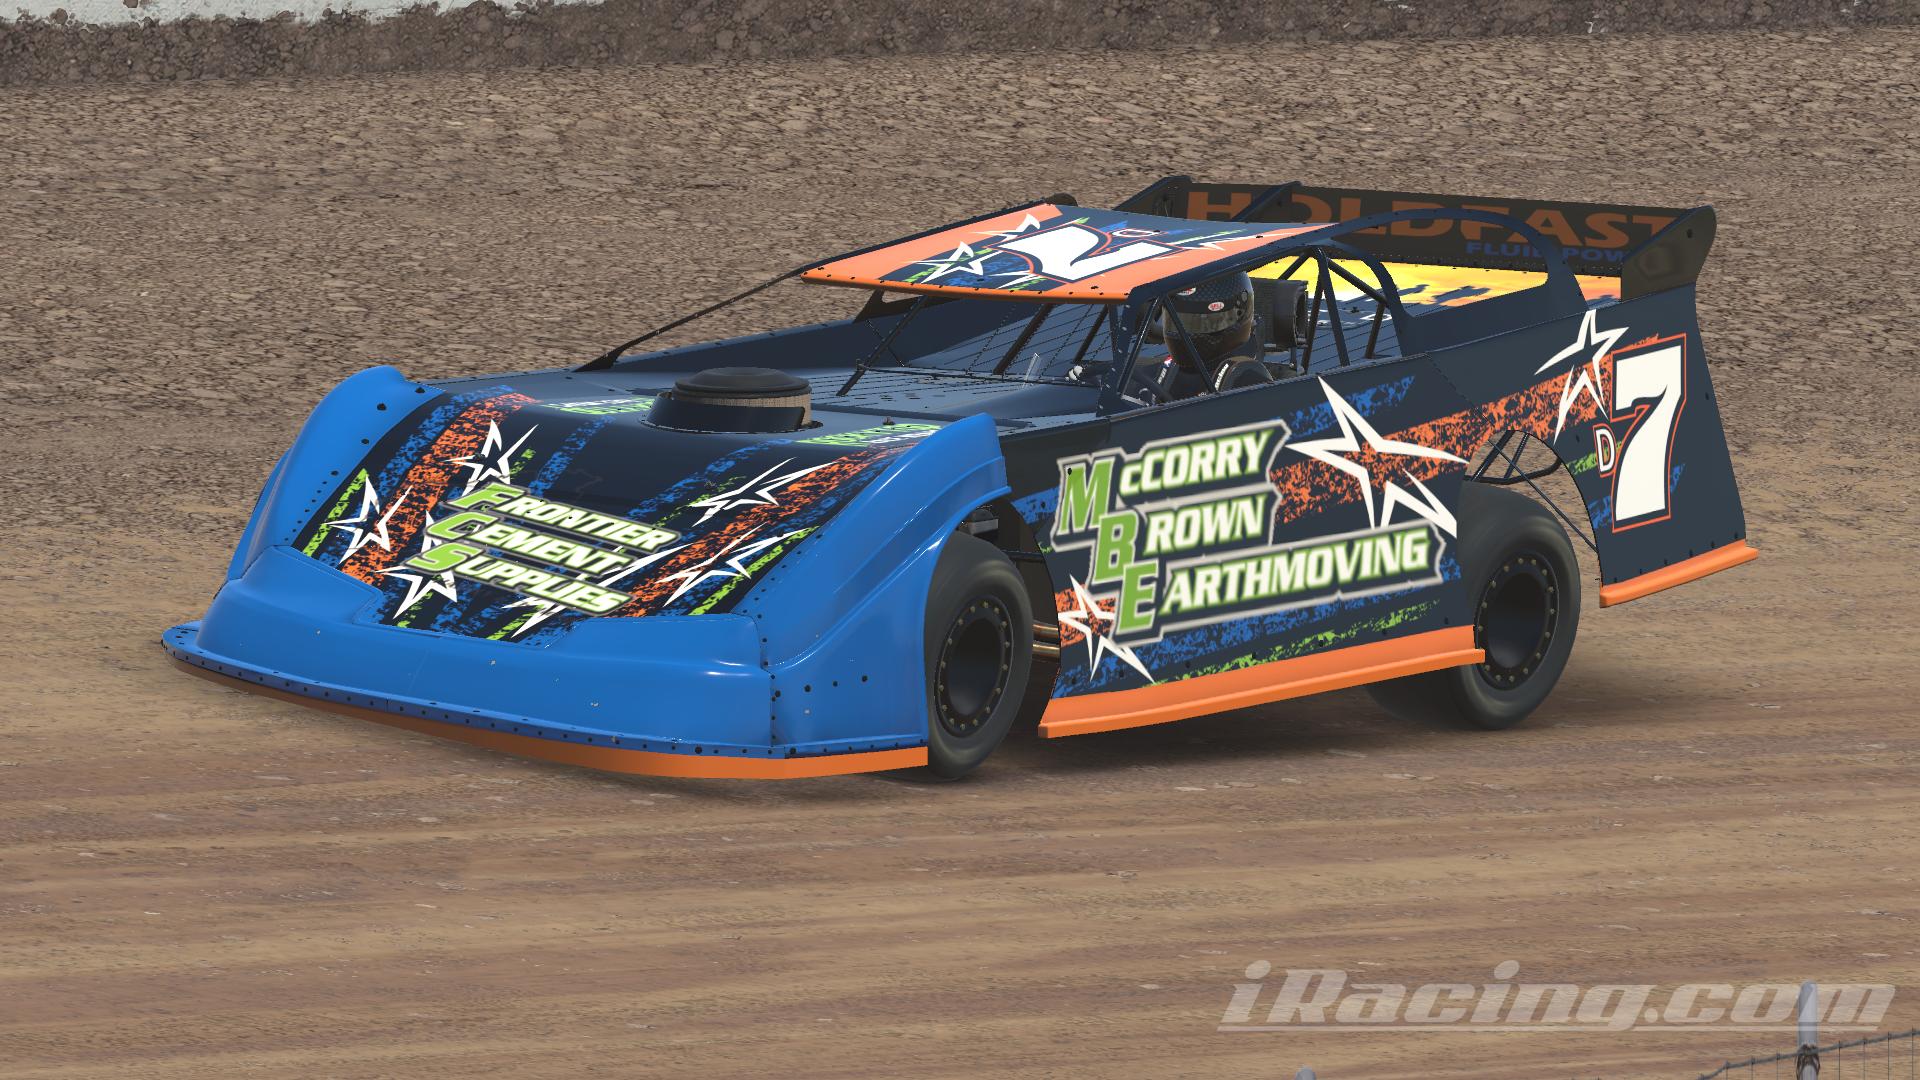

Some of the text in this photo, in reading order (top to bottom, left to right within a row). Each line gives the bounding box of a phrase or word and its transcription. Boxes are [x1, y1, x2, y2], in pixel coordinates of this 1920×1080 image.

[1562, 247, 1627, 263] POW
[1615, 345, 1682, 521] 7
[426, 511, 637, 575] CEMENT
[449, 482, 680, 550] FRONTIER
[1094, 496, 1268, 584] BROWN
[405, 542, 634, 612] SUPPLIES
[1117, 528, 1430, 632] EARTHMOVING
